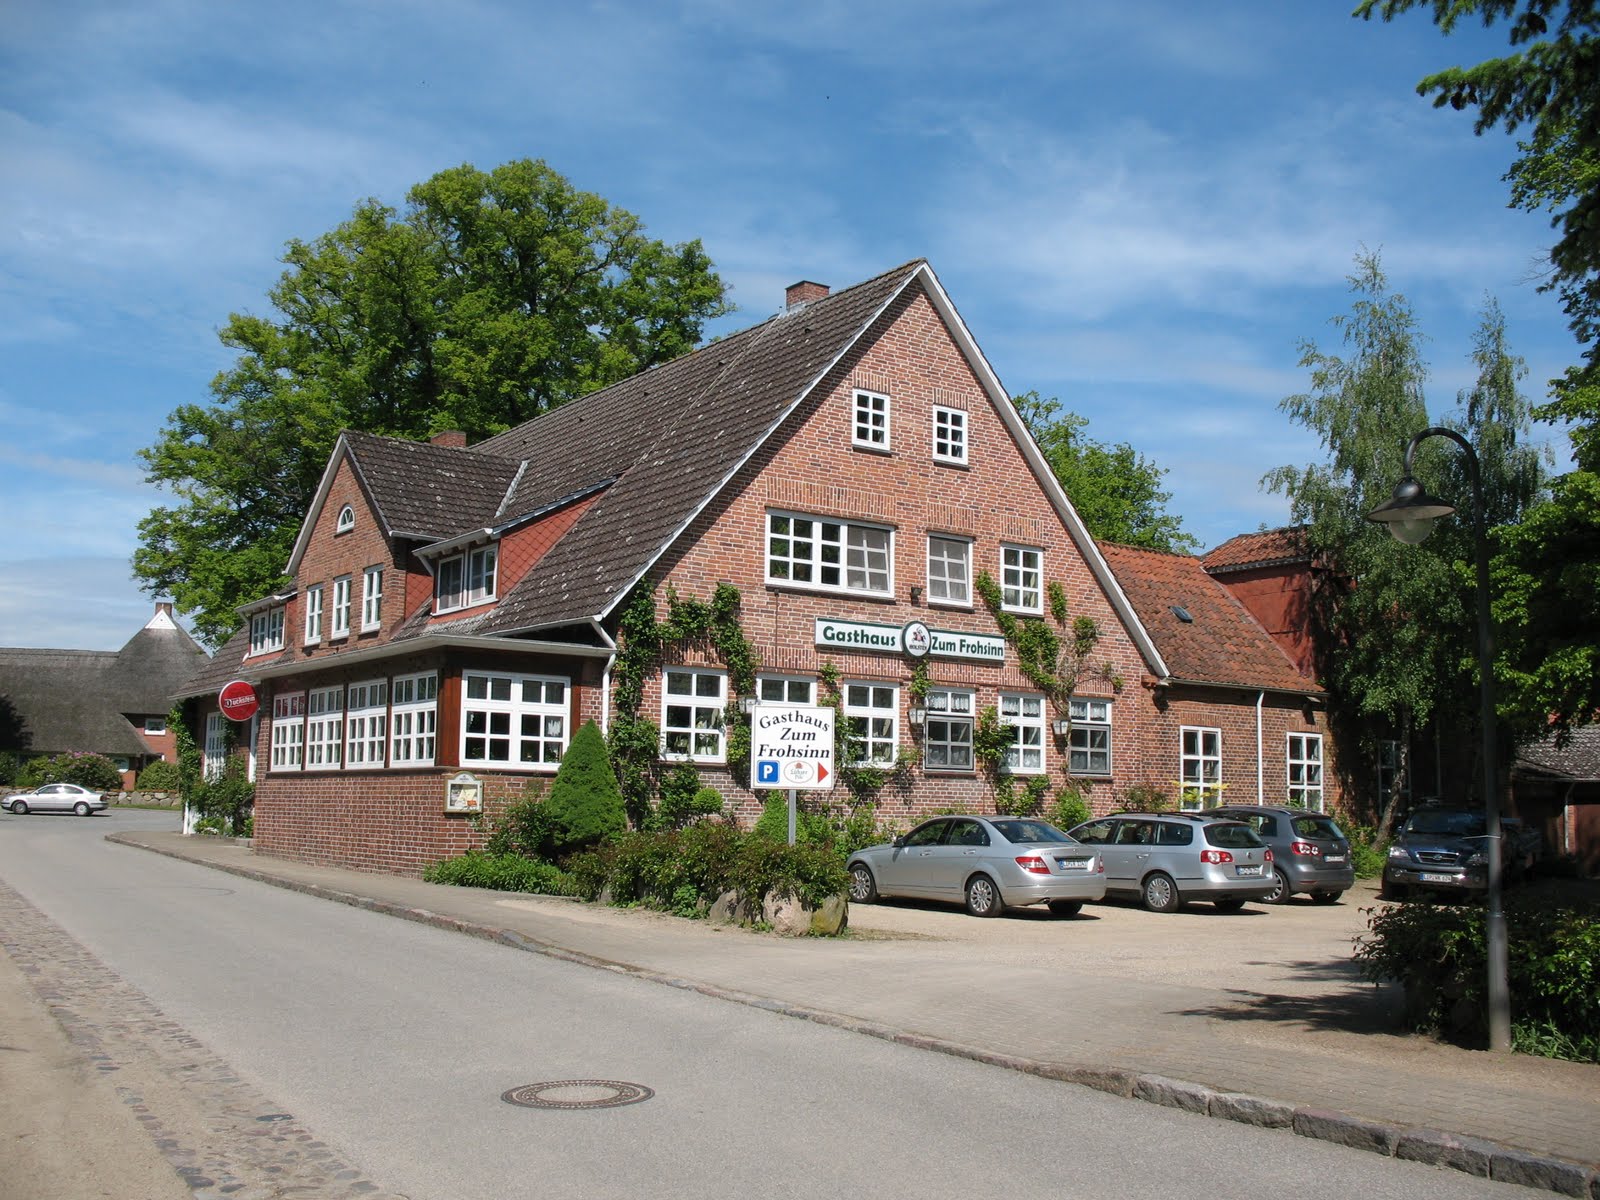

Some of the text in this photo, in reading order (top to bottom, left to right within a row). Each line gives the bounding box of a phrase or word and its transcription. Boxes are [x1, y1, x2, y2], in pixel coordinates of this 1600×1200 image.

[823, 625, 1004, 657] Gasthaus Zum Frohsinn
[759, 710, 830, 732] Gasthaus
[780, 727, 816, 741] Zum
[757, 744, 830, 759] Frohsinn
[763, 764, 773, 779] P
